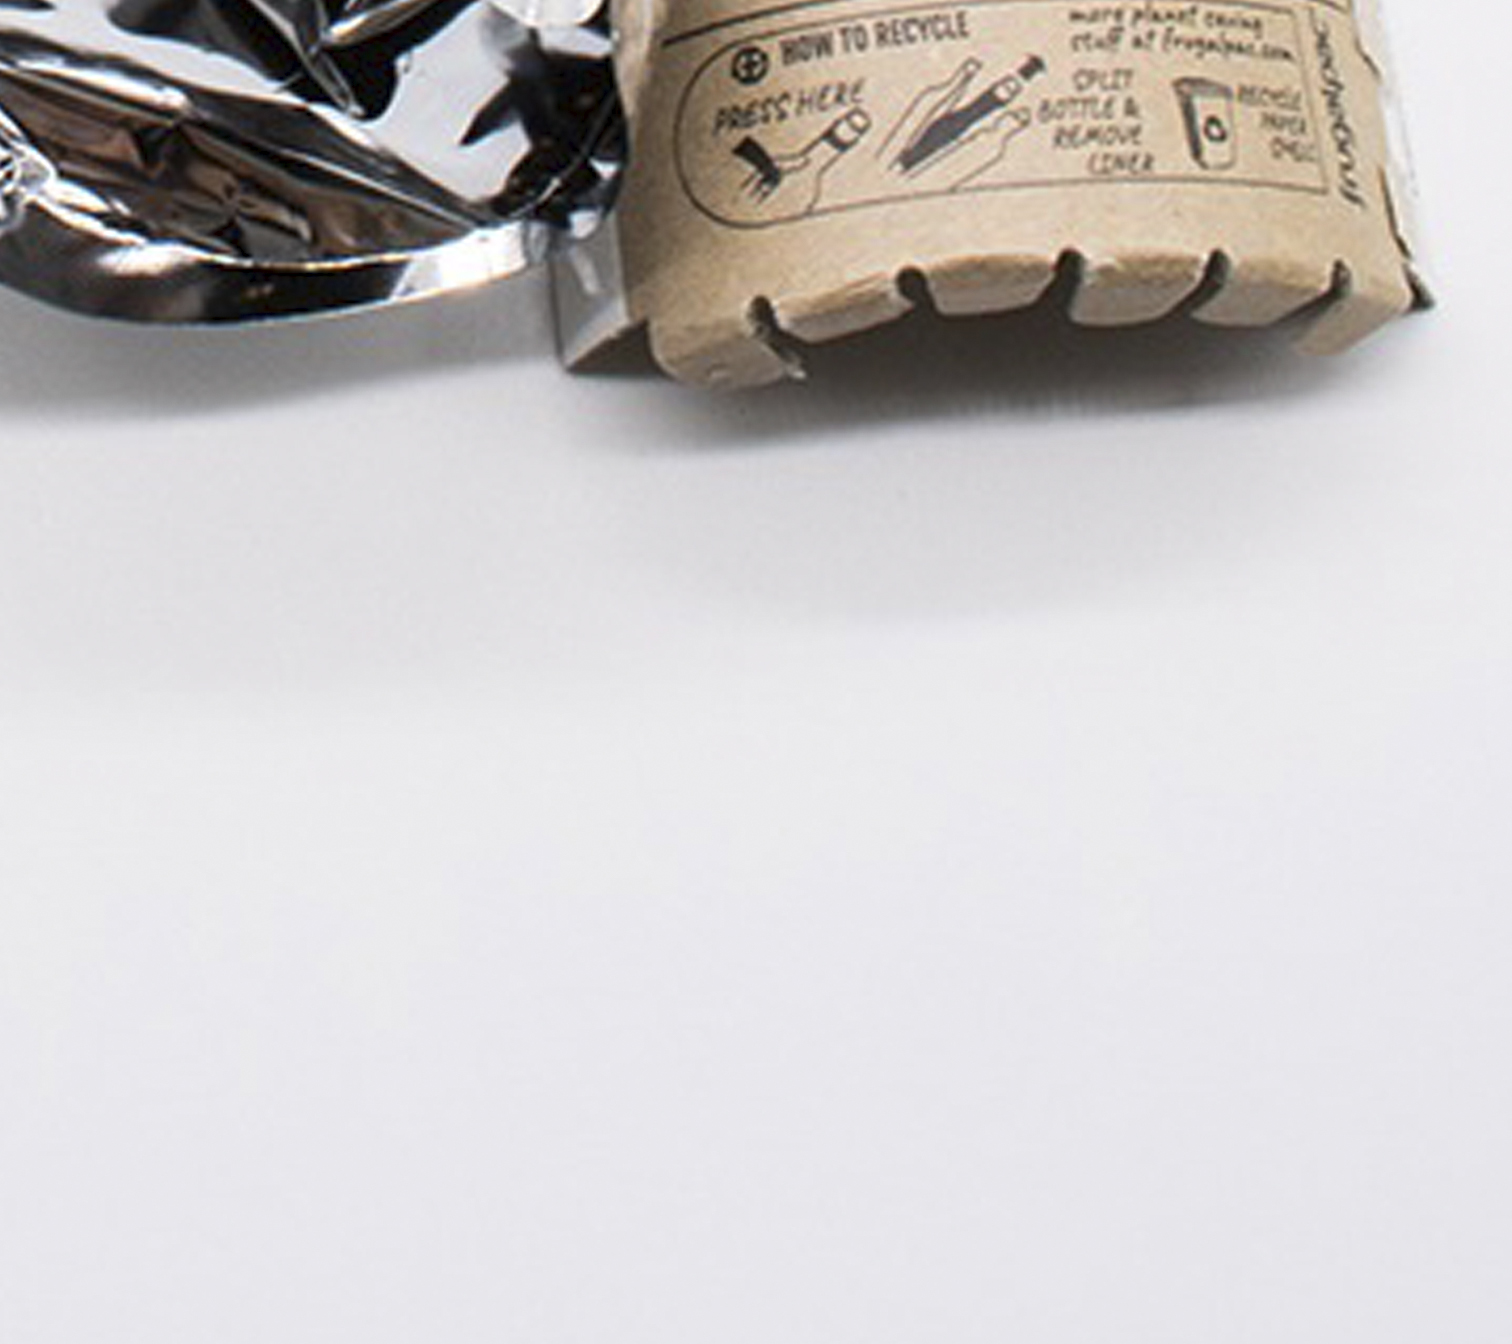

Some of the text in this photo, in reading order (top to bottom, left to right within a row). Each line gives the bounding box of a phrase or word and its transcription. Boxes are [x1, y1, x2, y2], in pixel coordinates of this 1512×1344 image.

[779, 11, 970, 66] HOW TO RECYCLE
[713, 91, 792, 136] PRESS
